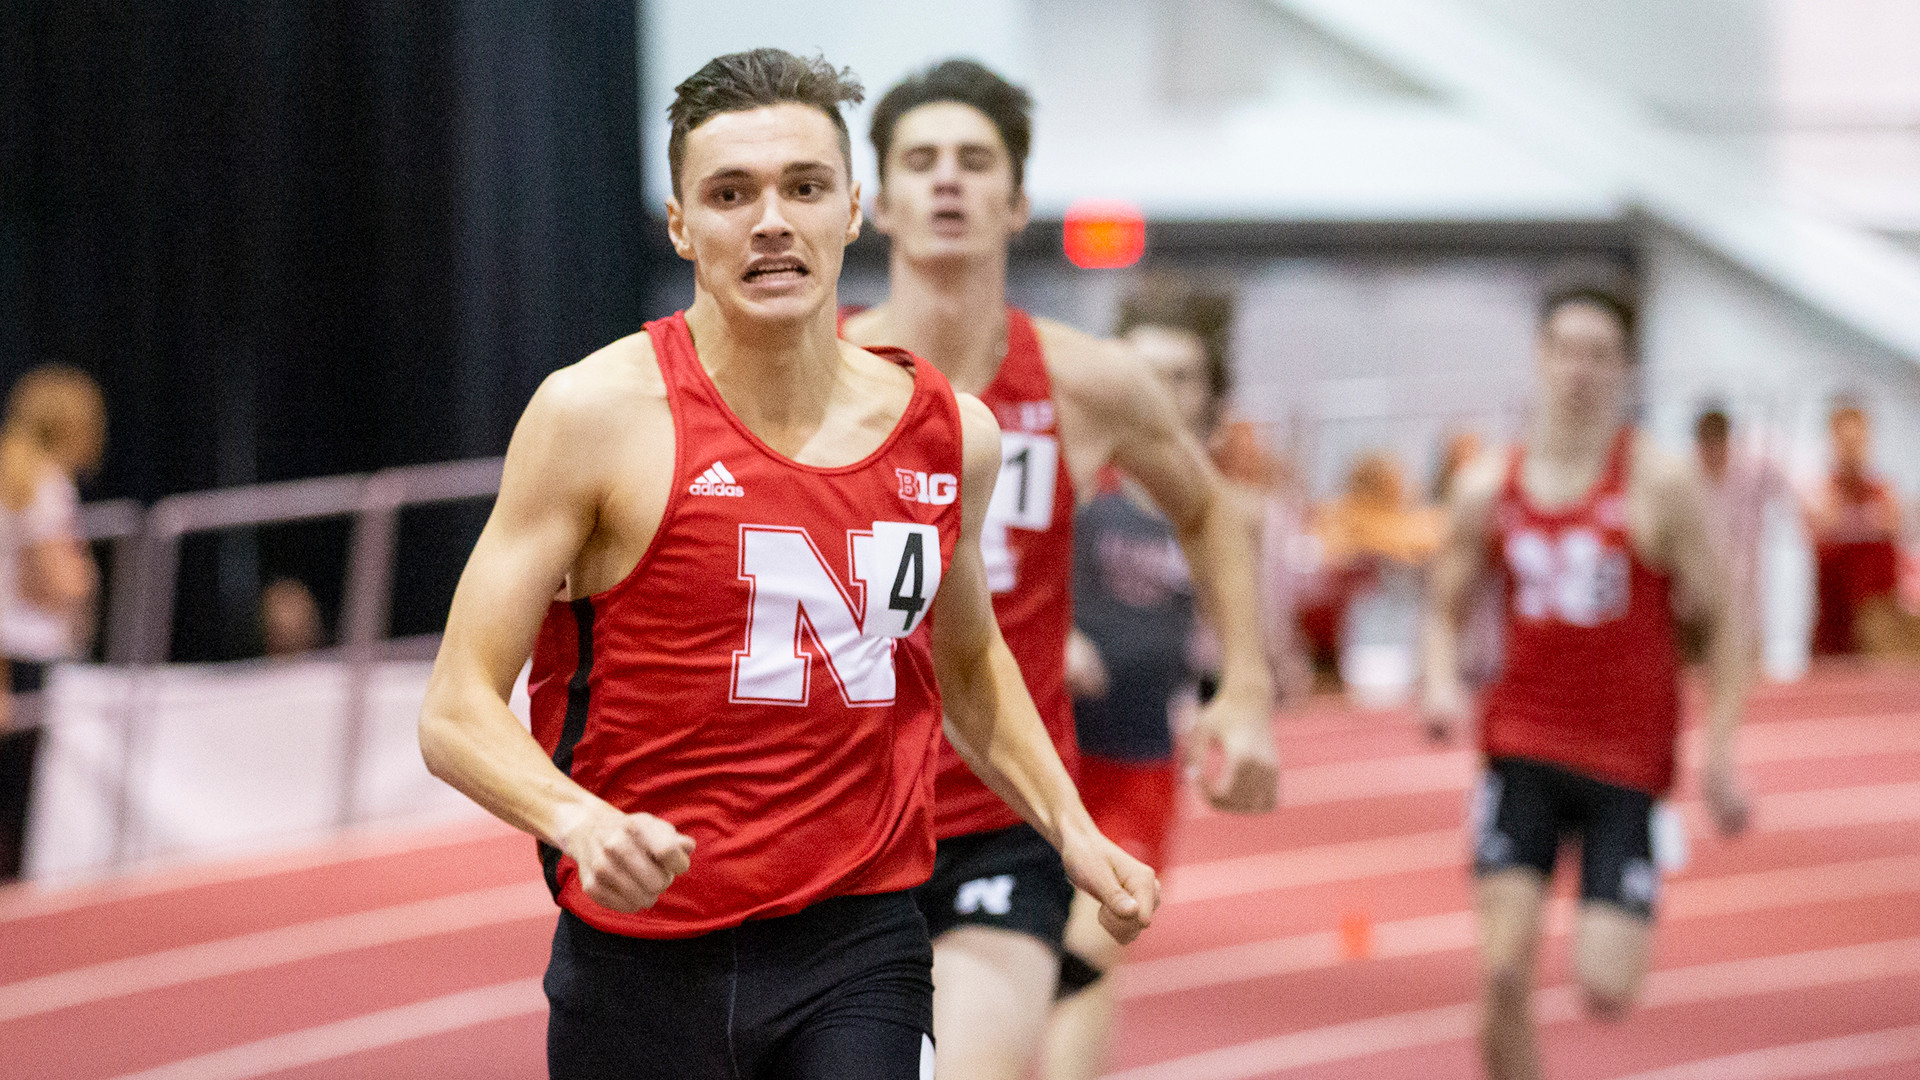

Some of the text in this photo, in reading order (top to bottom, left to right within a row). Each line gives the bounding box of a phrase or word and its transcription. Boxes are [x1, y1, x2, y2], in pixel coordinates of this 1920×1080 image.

[689, 481, 745, 498] adidas
[1006, 447, 1029, 513] 1
[729, 523, 896, 708] N
[889, 532, 926, 631] 4
